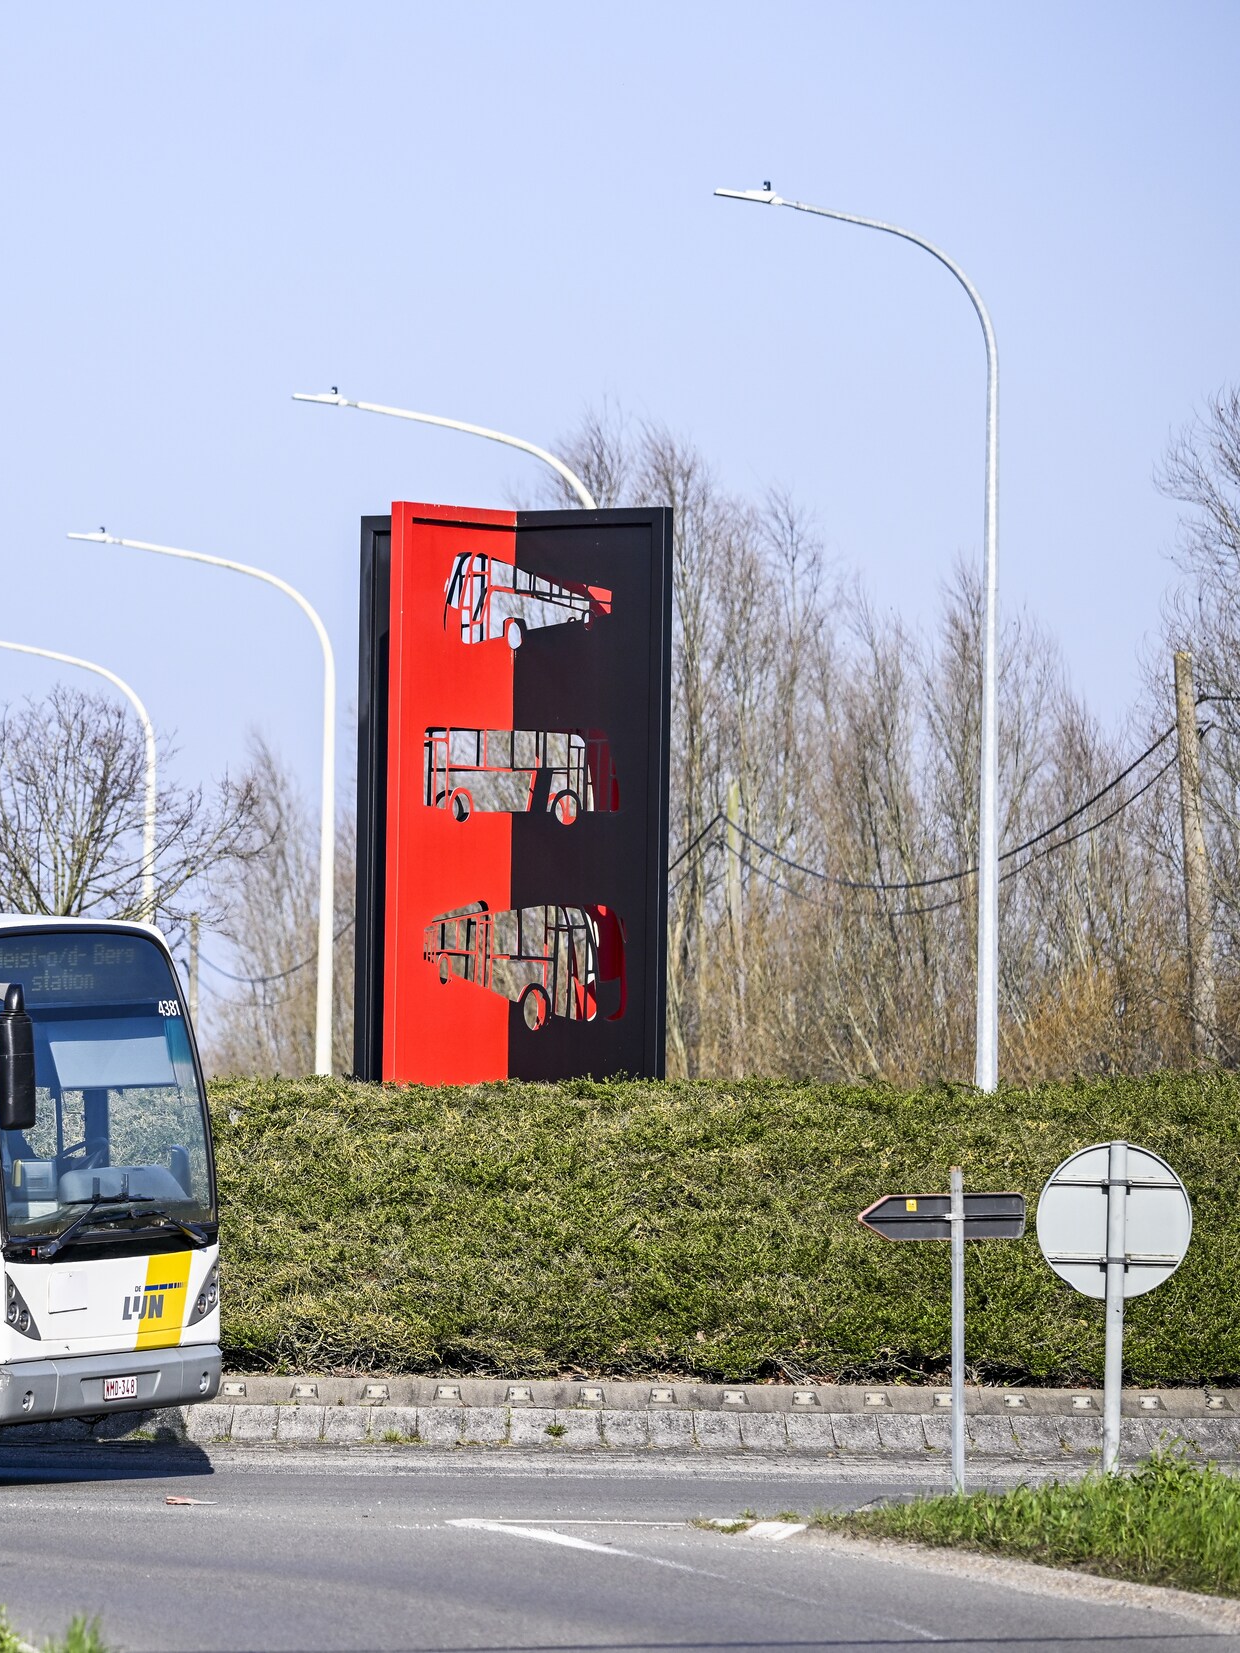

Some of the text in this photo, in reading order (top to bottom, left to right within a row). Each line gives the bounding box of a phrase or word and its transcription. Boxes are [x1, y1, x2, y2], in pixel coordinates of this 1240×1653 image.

[31, 969, 95, 991] station
[158, 1000, 181, 1017] 4381
[122, 1294, 164, 1320] LIJN
